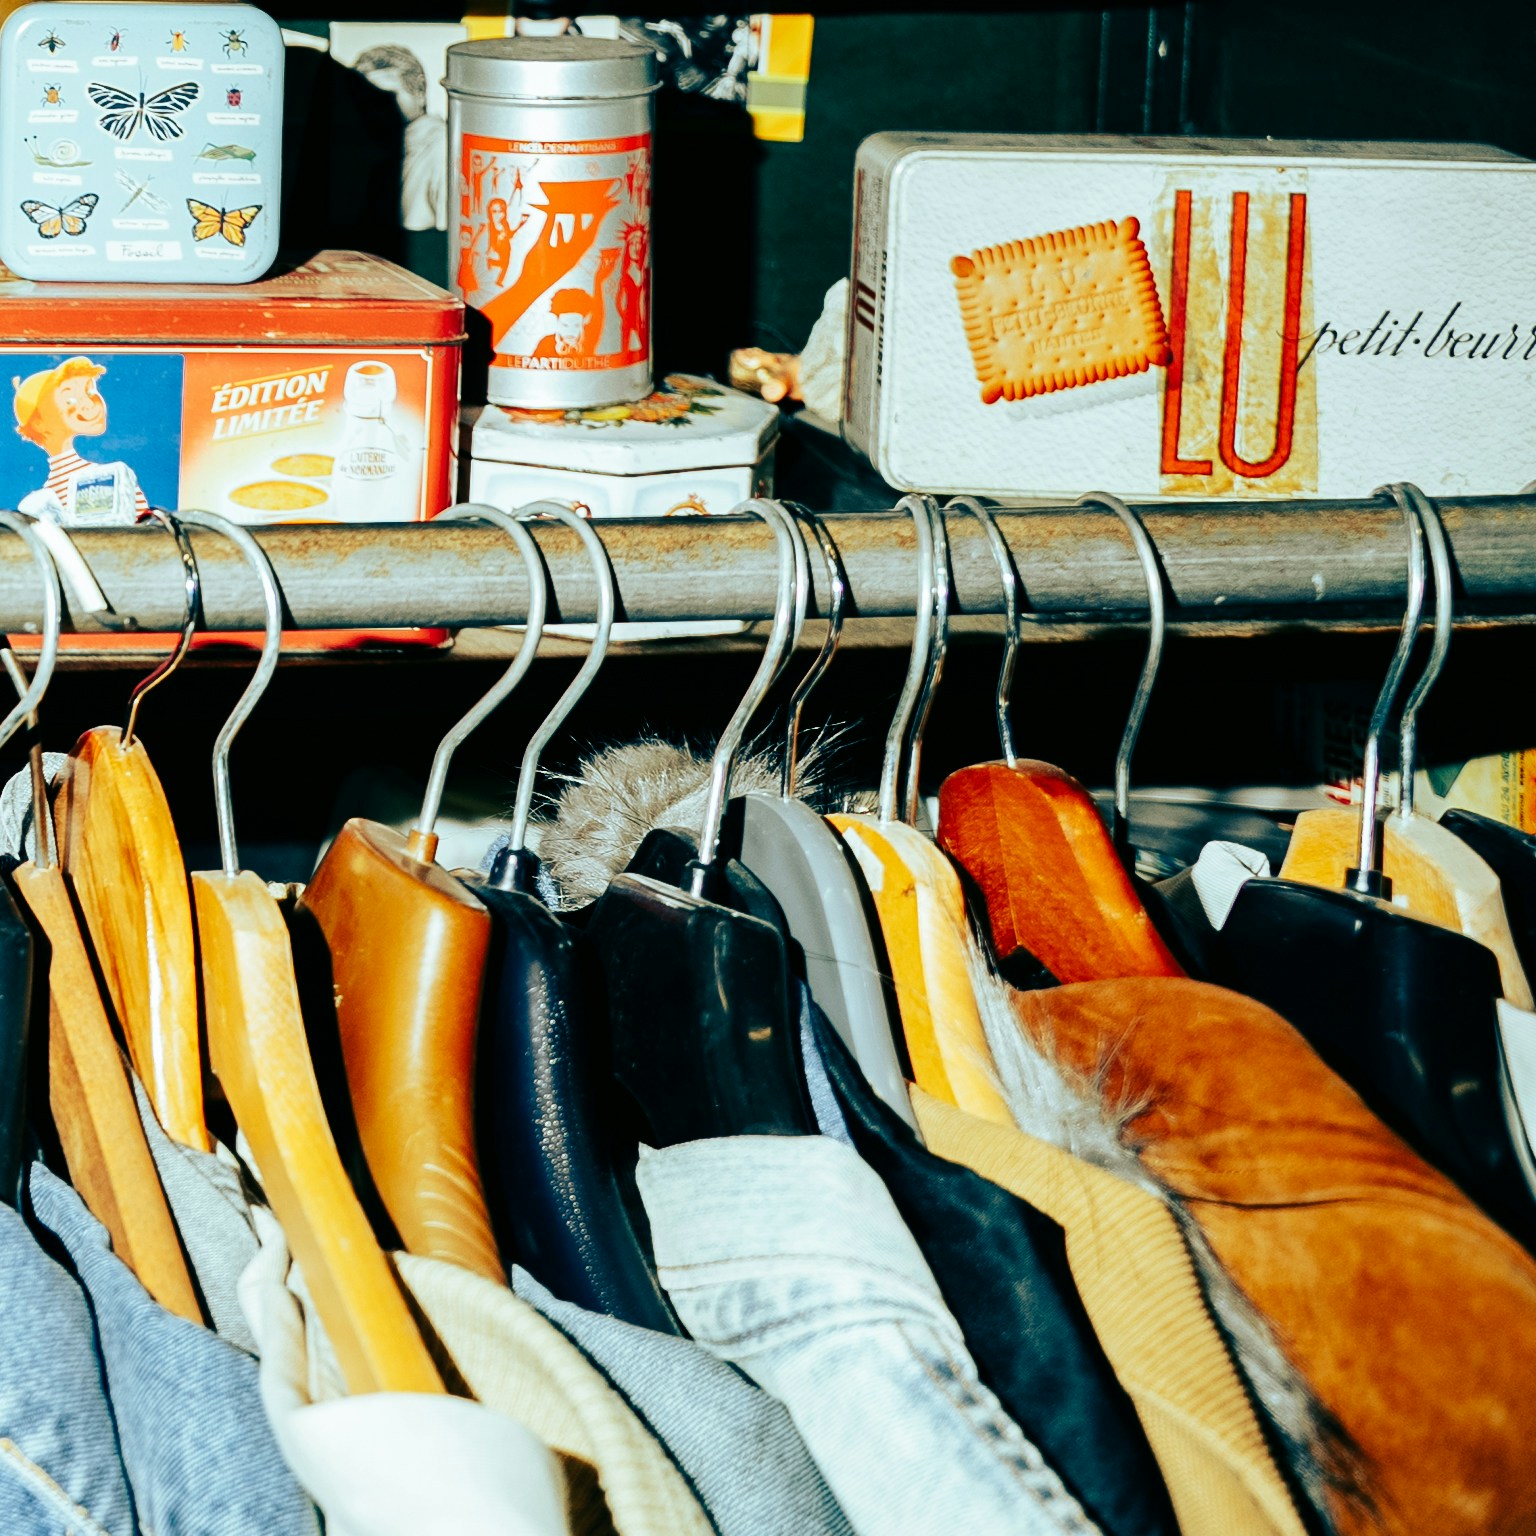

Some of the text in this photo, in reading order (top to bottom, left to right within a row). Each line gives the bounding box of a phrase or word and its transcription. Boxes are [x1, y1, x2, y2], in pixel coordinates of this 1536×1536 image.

[1161, 189, 1307, 478] LU
[211, 369, 329, 413] ÉDITION
[213, 397, 325, 440] LIMITÉE
